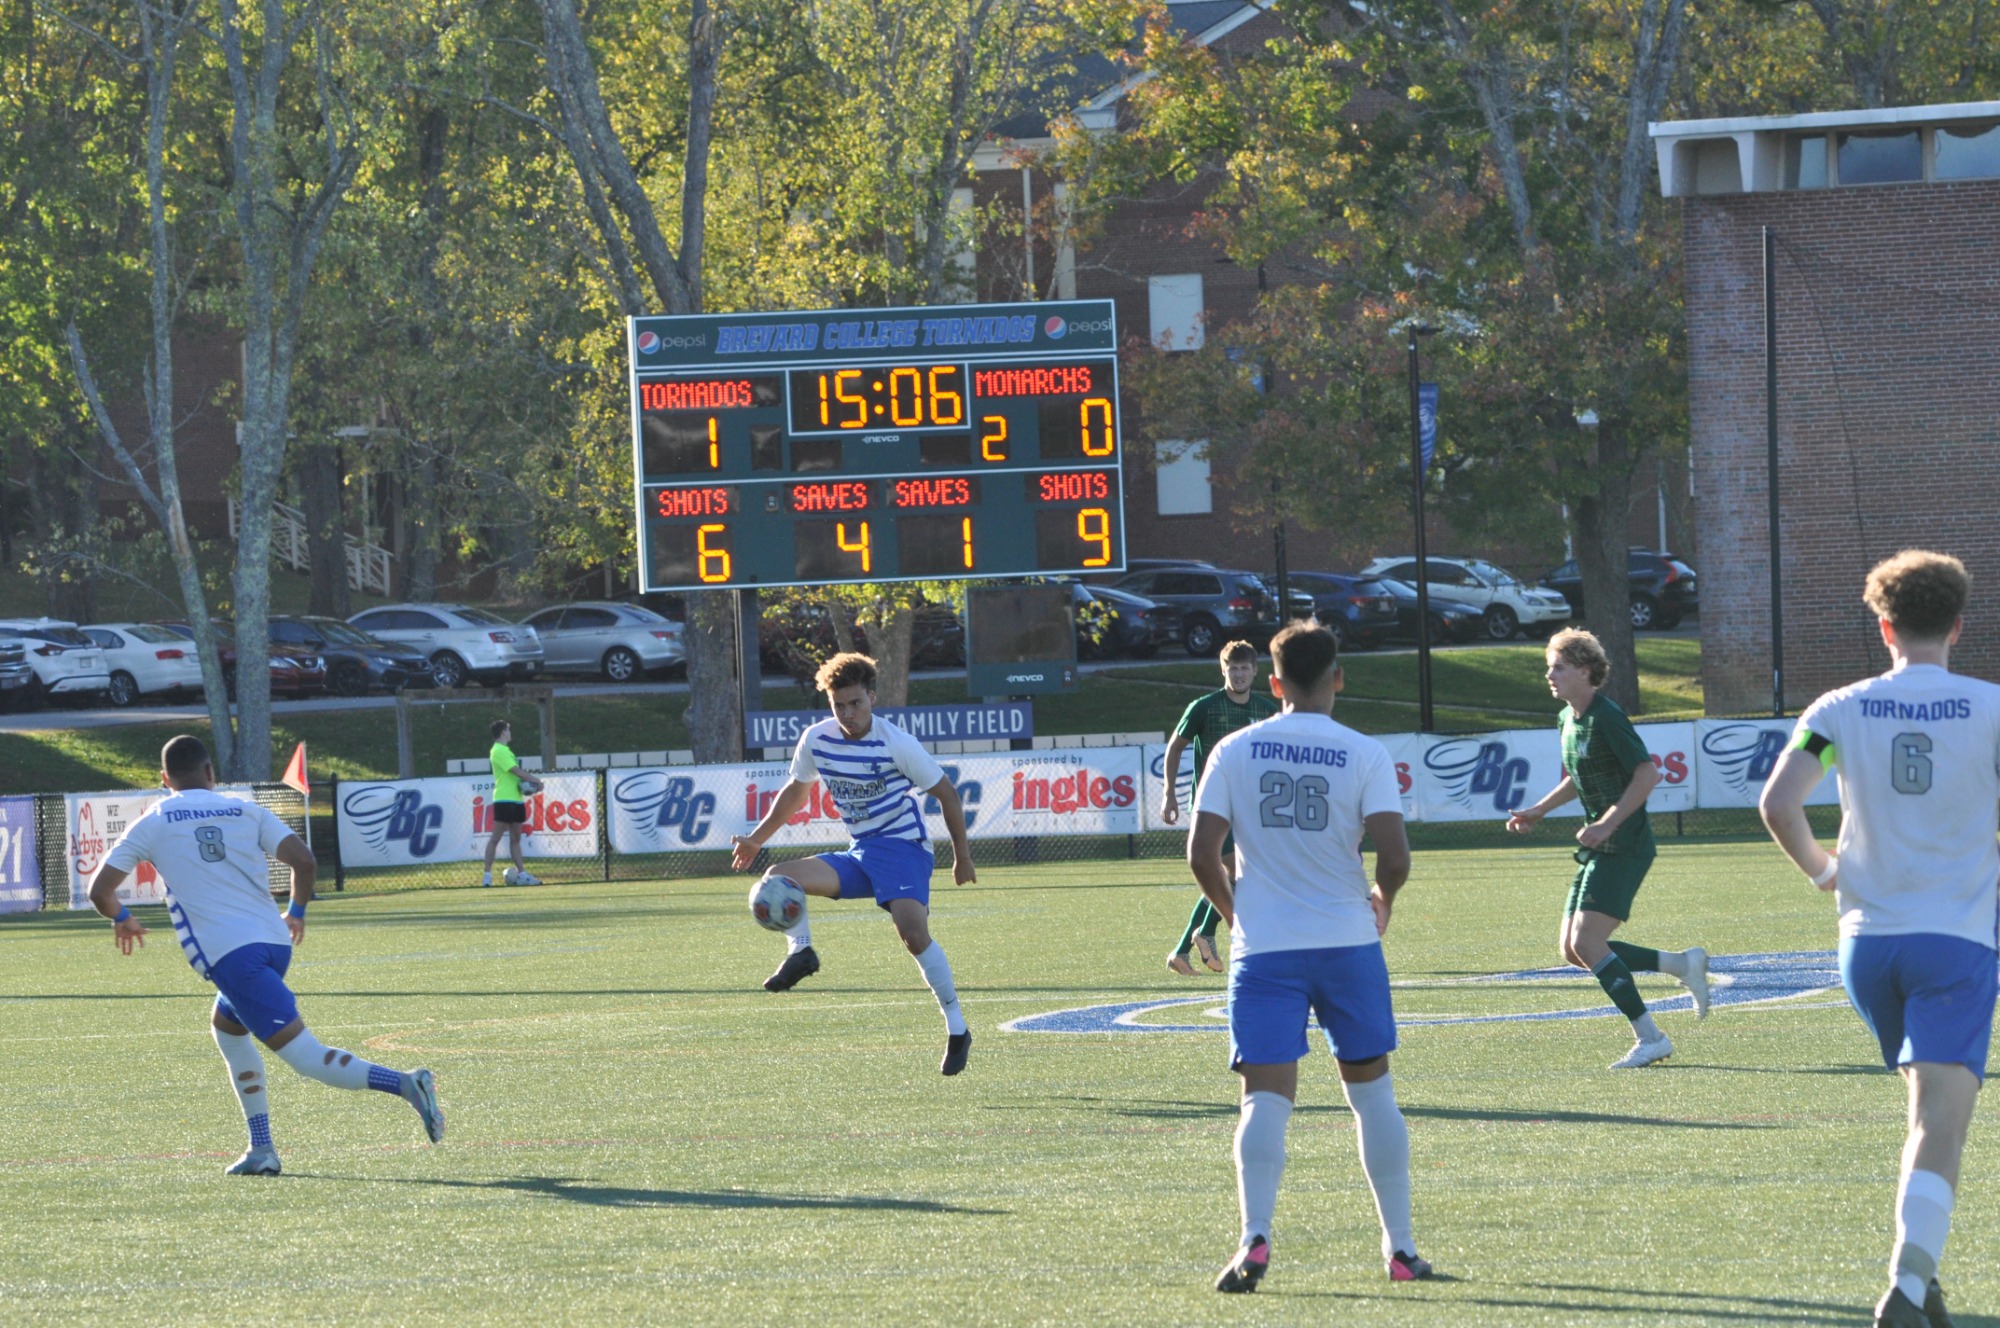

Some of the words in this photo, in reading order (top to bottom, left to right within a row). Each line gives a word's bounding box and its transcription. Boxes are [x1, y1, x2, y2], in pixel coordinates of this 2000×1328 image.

[662, 333, 707, 348] pepsi
[715, 322, 819, 354] BREVARD
[823, 319, 920, 351] COLLEGE
[922, 315, 1037, 346] TORNADOS
[1068, 317, 1113, 335] pepsi
[640, 380, 752, 410] TORNADOS
[818, 366, 962, 428] 15:06
[975, 366, 1092, 397] MONARCHS
[708, 417, 720, 469] 1
[981, 415, 1007, 461] 2
[1080, 397, 1114, 456] 0
[658, 488, 728, 516] SHOTS
[793, 483, 868, 511] SAVES
[896, 478, 970, 506] SAVES
[1039, 473, 1108, 500] SHOTS
[697, 524, 732, 583] 6
[836, 521, 871, 573] 4
[962, 517, 973, 568] 1
[1077, 508, 1111, 567] 9
[966, 708, 1024, 734] FIELD
[1859, 698, 1971, 721] TORNADOS
[1012, 754, 1067, 767] sponsored
[1071, 754, 1084, 766] by
[1250, 741, 1347, 768] TORNADOS
[1891, 732, 1933, 795] 6
[1012, 768, 1136, 815] ingles
[1470, 741, 1531, 812] BC
[107, 805, 119, 817] WE
[657, 775, 717, 845] BC
[1260, 770, 1330, 831] 26
[386, 789, 444, 858] BC
[70, 831, 104, 861] Arby's
[194, 826, 226, 863] 8
